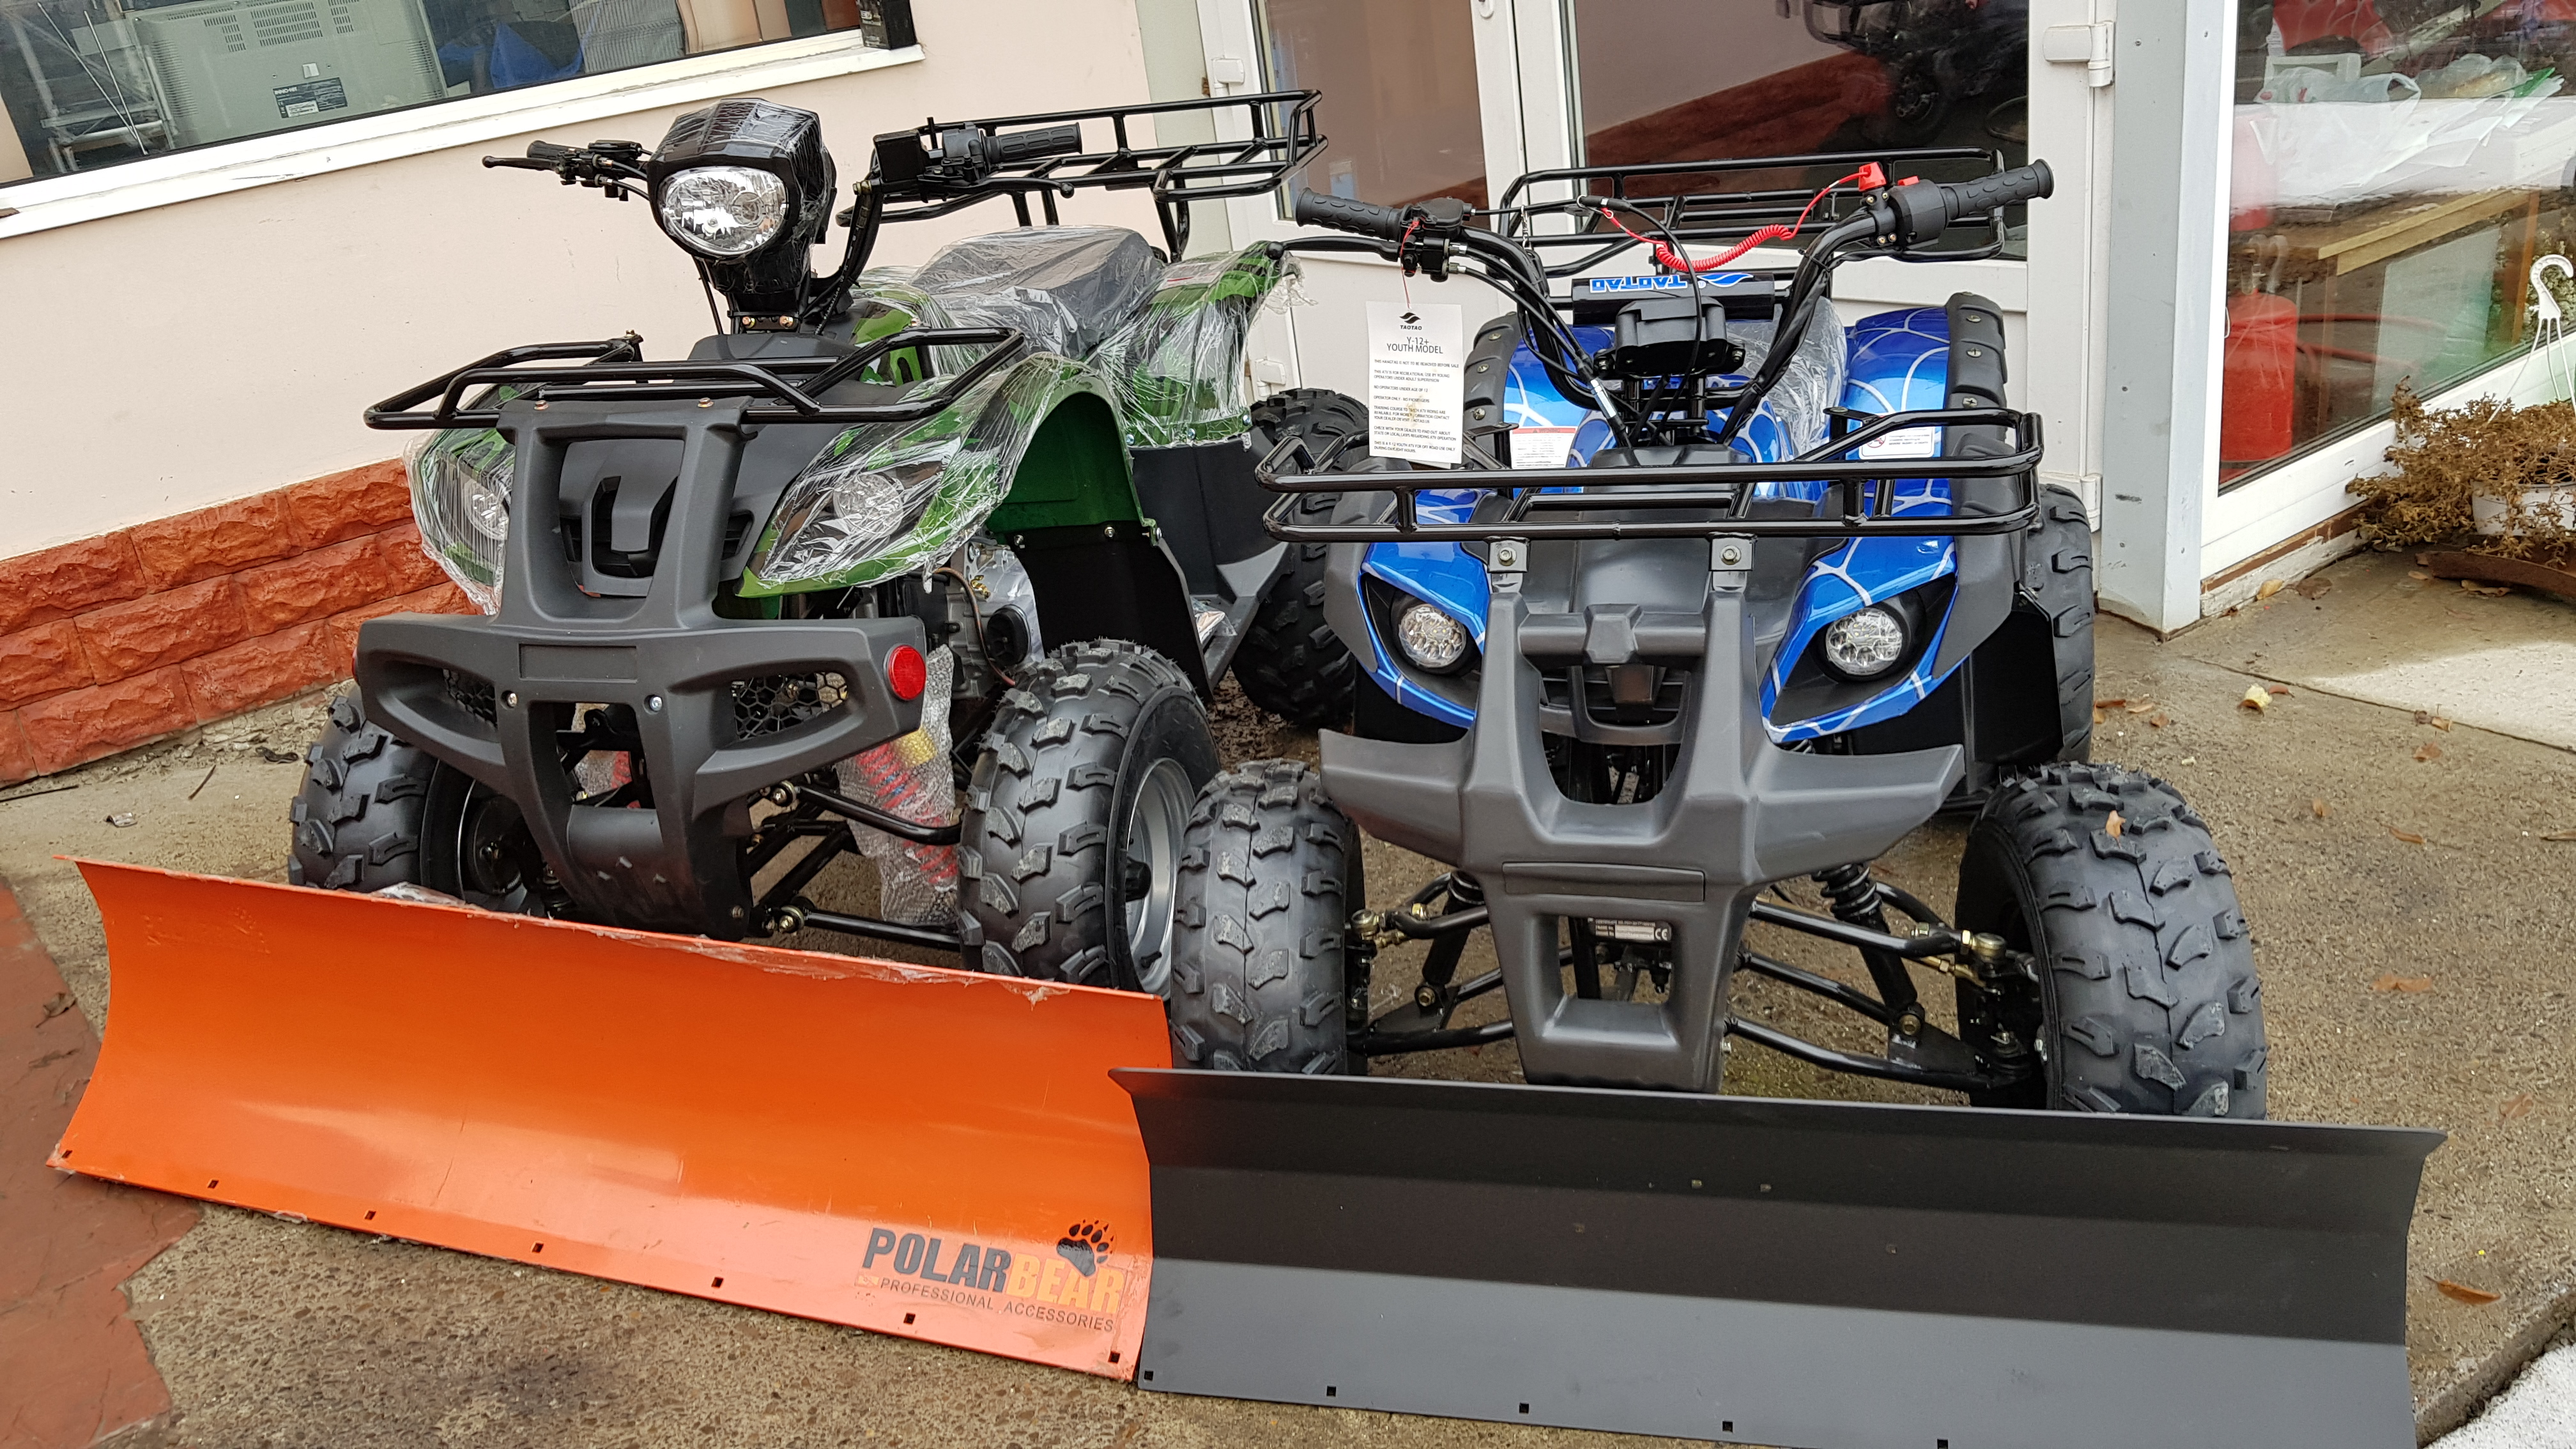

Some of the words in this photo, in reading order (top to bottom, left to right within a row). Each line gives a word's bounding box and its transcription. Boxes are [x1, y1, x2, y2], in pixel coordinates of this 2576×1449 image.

[1590, 275, 1688, 293] TAOTAO
[1407, 336, 1429, 345] Y-12+
[1386, 343, 1413, 352] YOUTH
[1416, 344, 1443, 354] MODEL
[880, 1276, 994, 1310] PROFESSIONAL
[1003, 1301, 1115, 1333] ACCESSORIES
